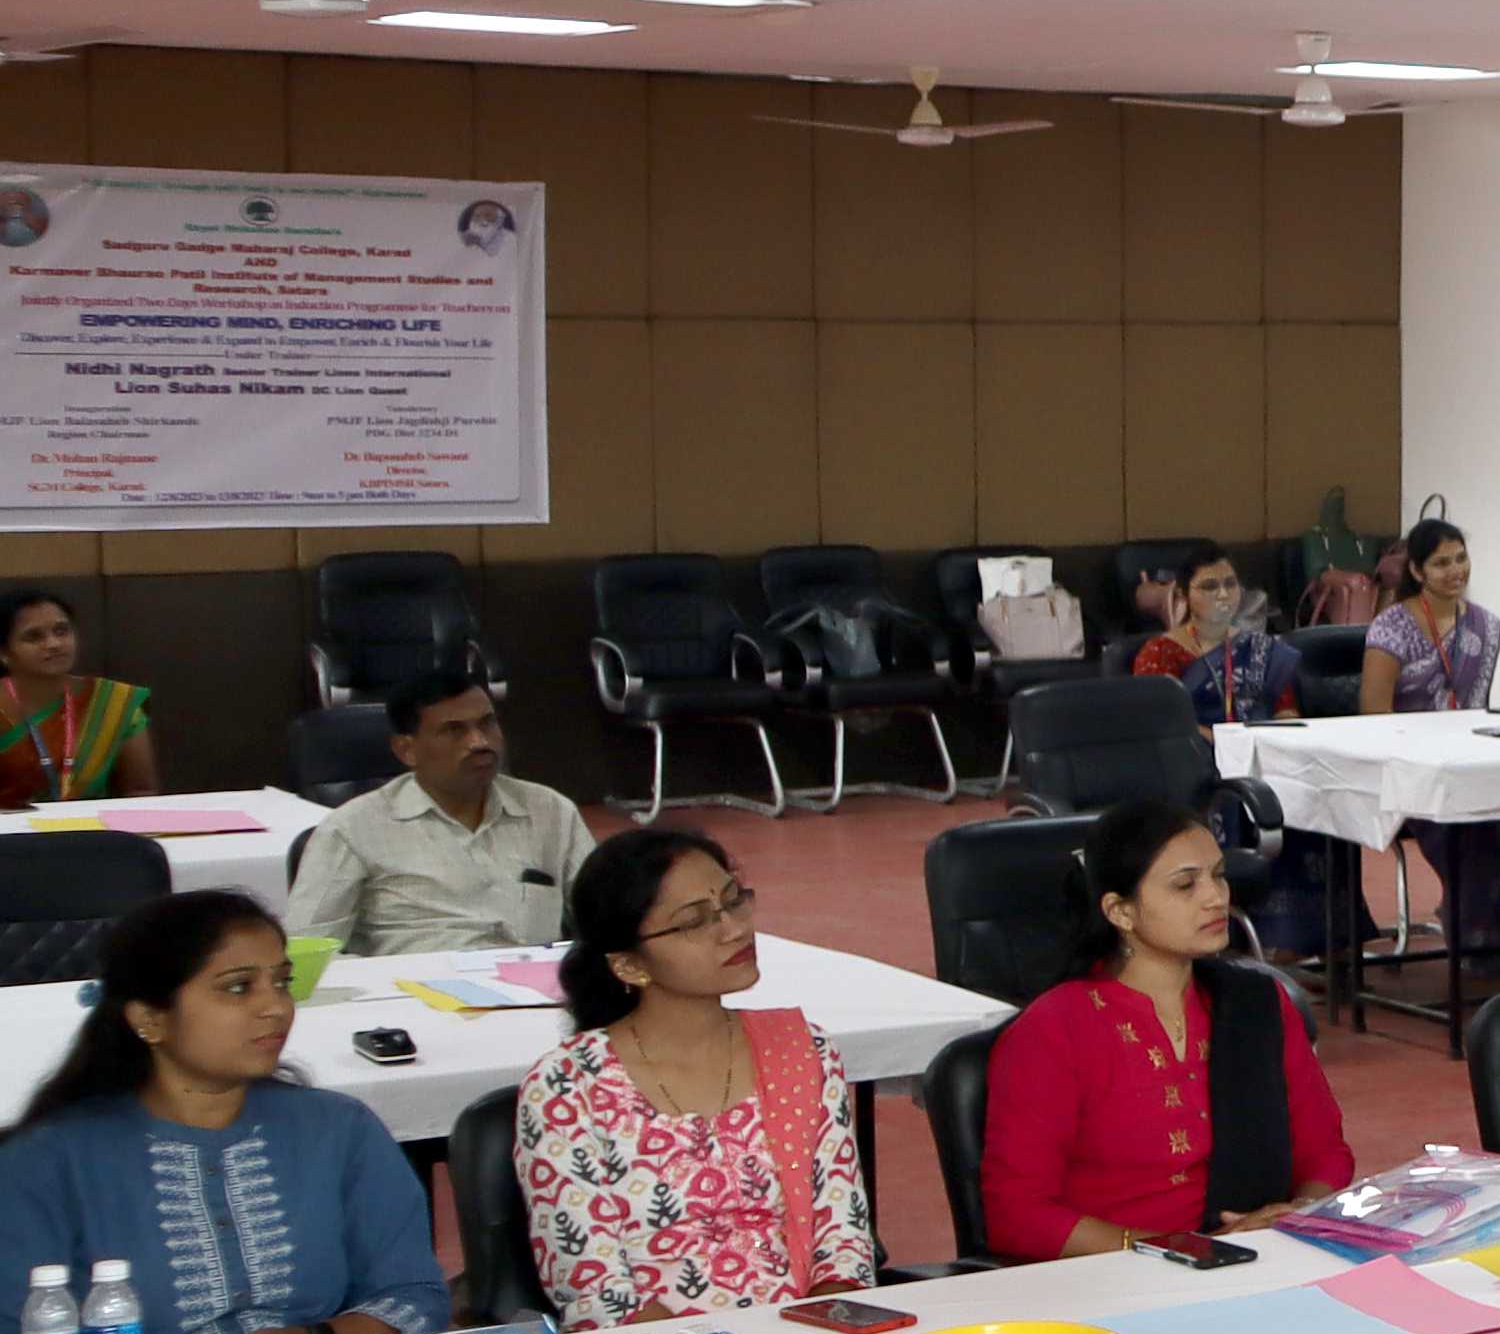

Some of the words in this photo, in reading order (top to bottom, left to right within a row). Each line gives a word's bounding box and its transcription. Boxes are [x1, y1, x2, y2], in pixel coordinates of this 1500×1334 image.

[79, 314, 221, 328] EMPOWERING
[226, 315, 283, 330] MIND,
[289, 317, 396, 332] ENRICHING
[401, 318, 442, 332] LIFE
[65, 362, 122, 375] Nidhi
[128, 363, 215, 378] Nagrath
[114, 382, 160, 394] Lion
[167, 382, 232, 395] Suhas
[239, 383, 304, 395] Nikam
